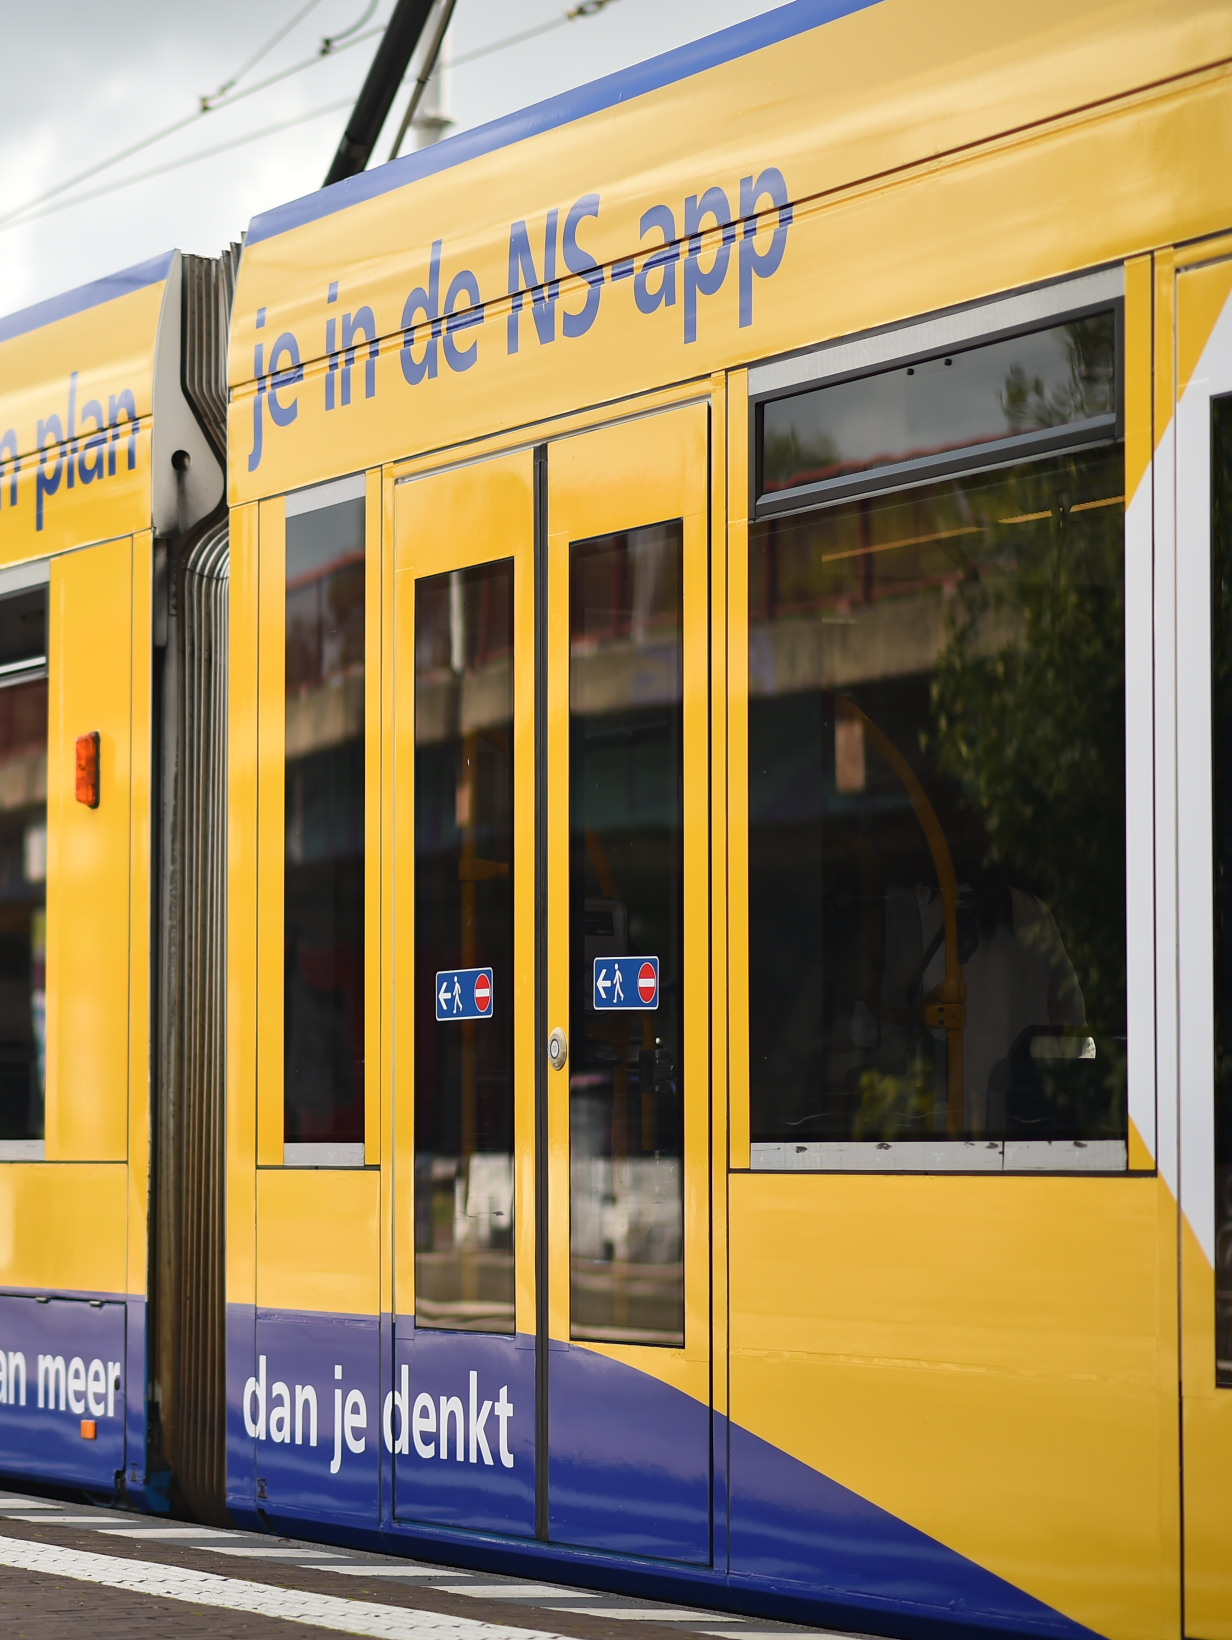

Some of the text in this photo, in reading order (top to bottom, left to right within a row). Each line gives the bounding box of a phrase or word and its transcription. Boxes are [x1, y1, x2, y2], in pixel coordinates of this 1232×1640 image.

[247, 166, 794, 472] je in de NS-app
[35, 371, 141, 532] plan
[37, 1353, 120, 1417] meer
[243, 1355, 514, 1474] dan je denkt
